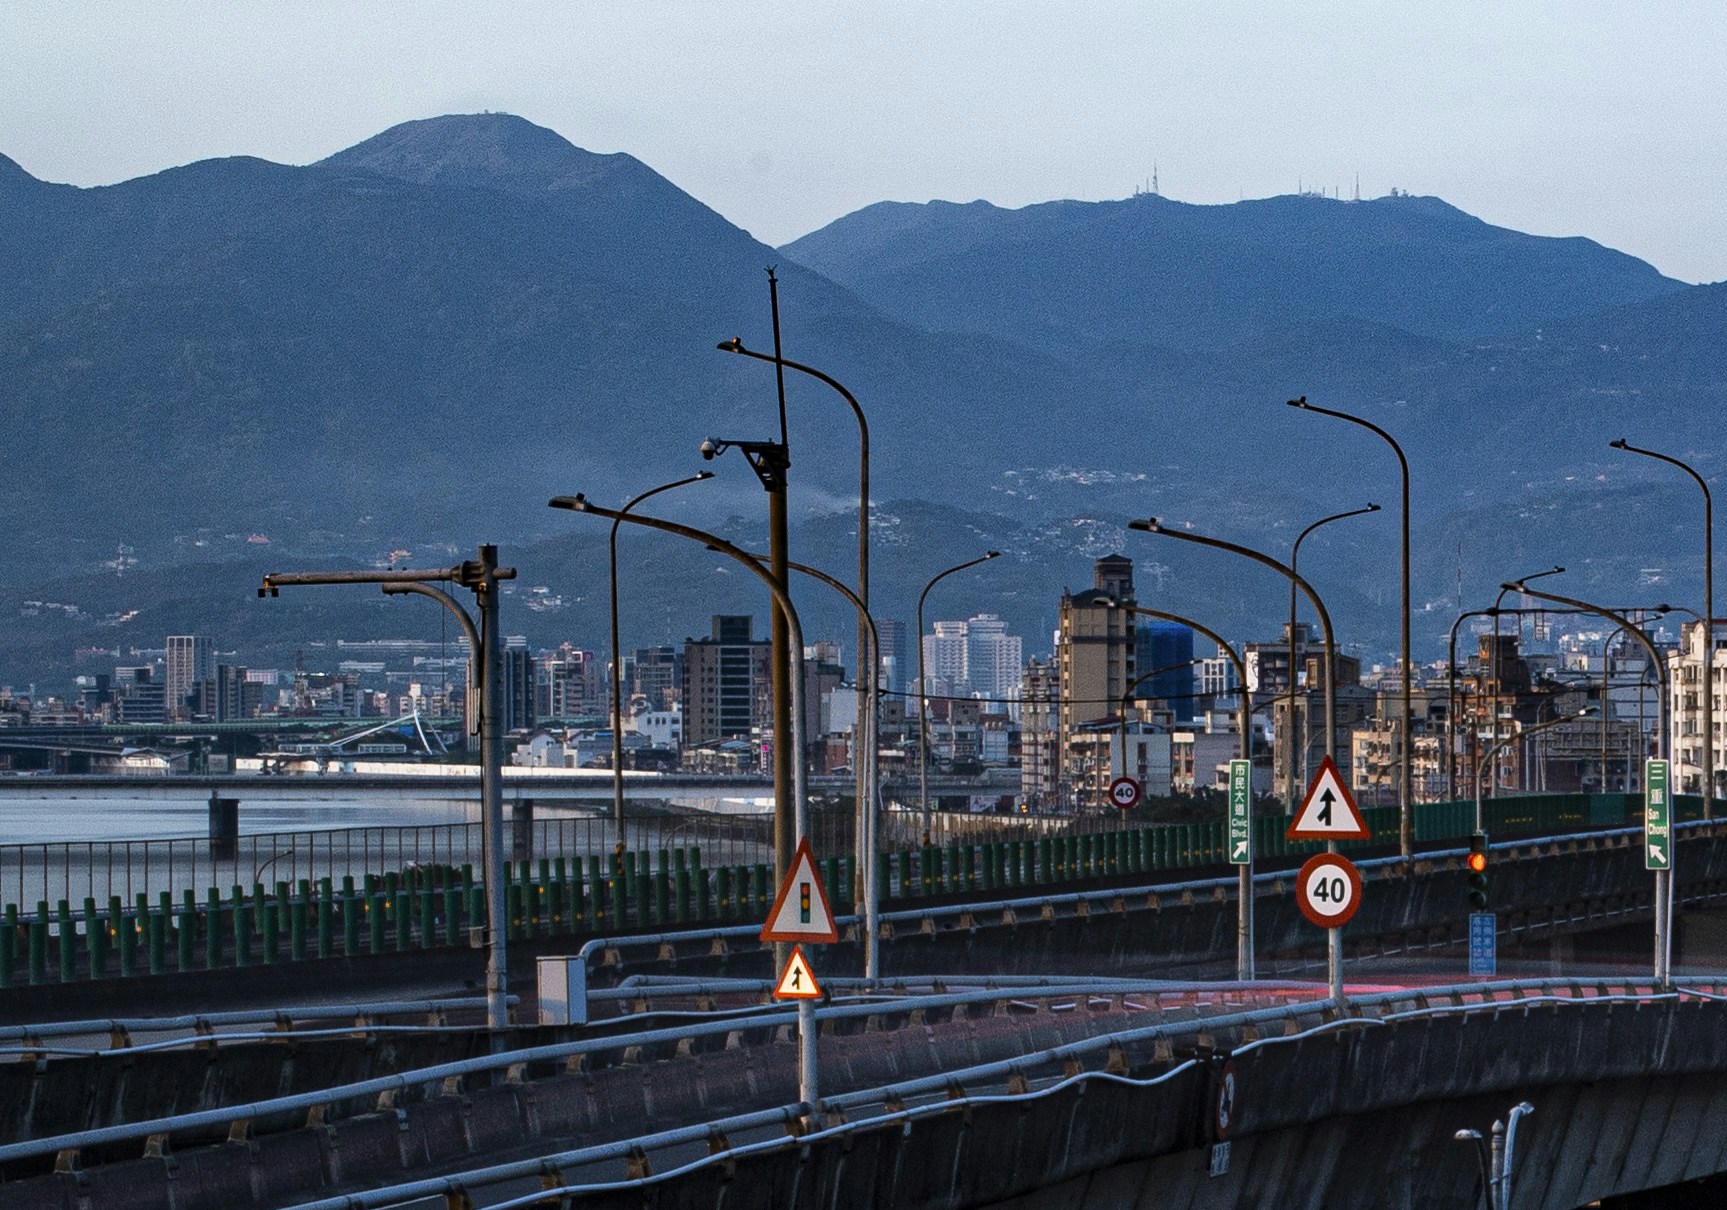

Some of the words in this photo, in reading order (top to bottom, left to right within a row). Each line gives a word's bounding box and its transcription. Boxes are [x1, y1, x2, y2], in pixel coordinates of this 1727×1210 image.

[1234, 764, 1245, 816] 市民大道
[1650, 764, 1664, 805] 三重
[1116, 788, 1133, 797] 40
[1648, 808, 1660, 820] San
[1232, 818, 1247, 827] Civic
[1648, 823, 1666, 838] Chong
[1313, 877, 1346, 904] 40
